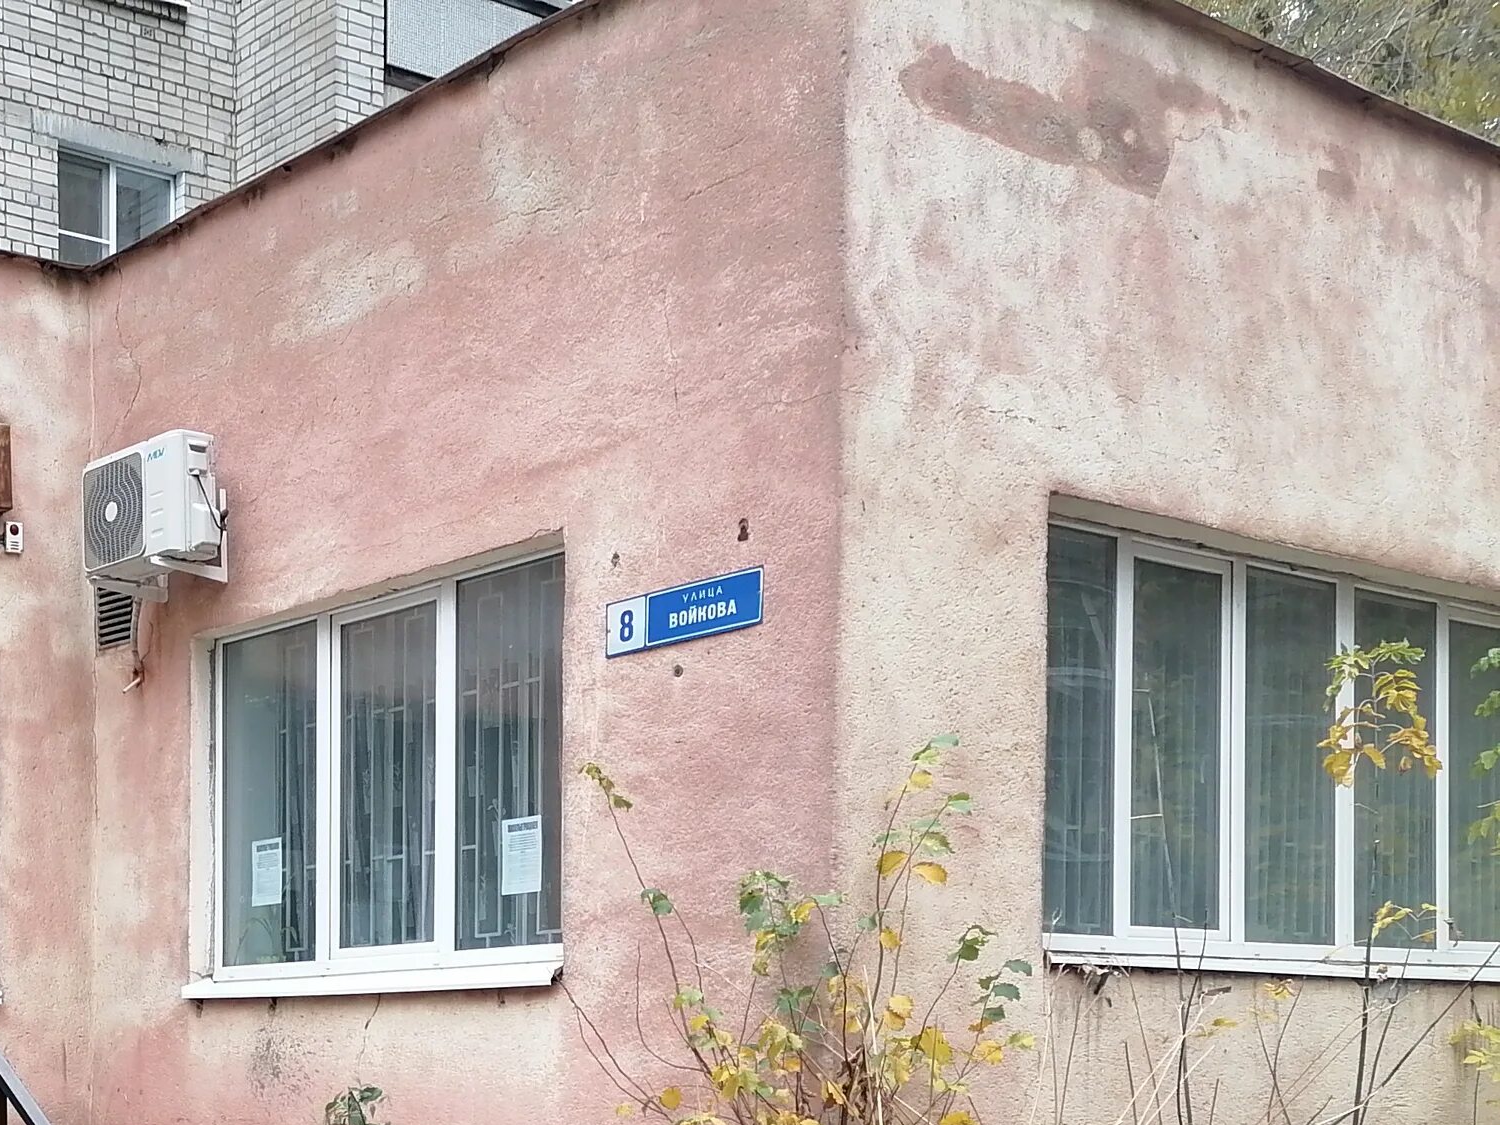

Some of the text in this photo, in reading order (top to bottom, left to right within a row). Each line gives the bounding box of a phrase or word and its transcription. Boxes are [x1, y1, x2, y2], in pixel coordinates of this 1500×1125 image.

[682, 585, 723, 603] УЛИЦА
[619, 609, 634, 642] 8
[669, 599, 737, 629] ВОЙКОВА
